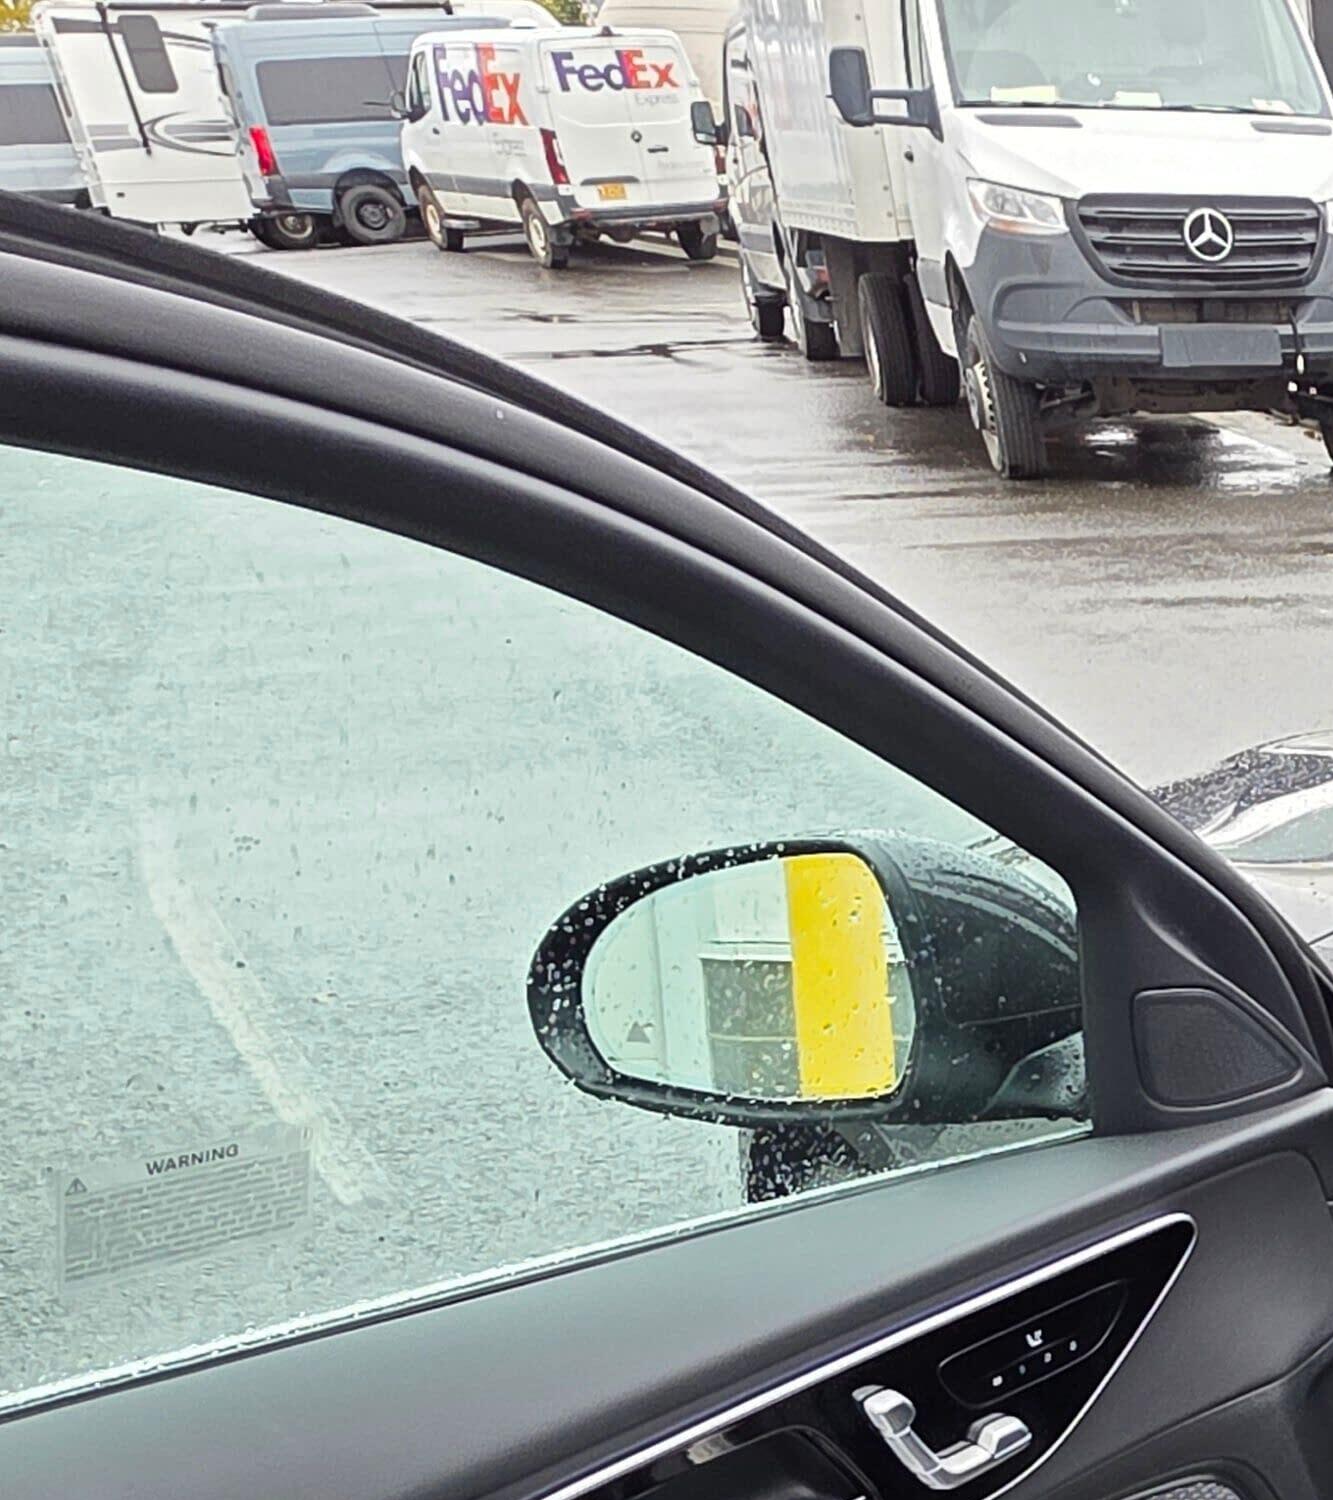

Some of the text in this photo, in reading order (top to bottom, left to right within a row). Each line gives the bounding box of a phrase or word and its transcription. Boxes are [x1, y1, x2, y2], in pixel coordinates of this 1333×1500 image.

[432, 43, 529, 126] FedEx
[551, 49, 681, 92] FedEx
[145, 1143, 240, 1176] WARNING
